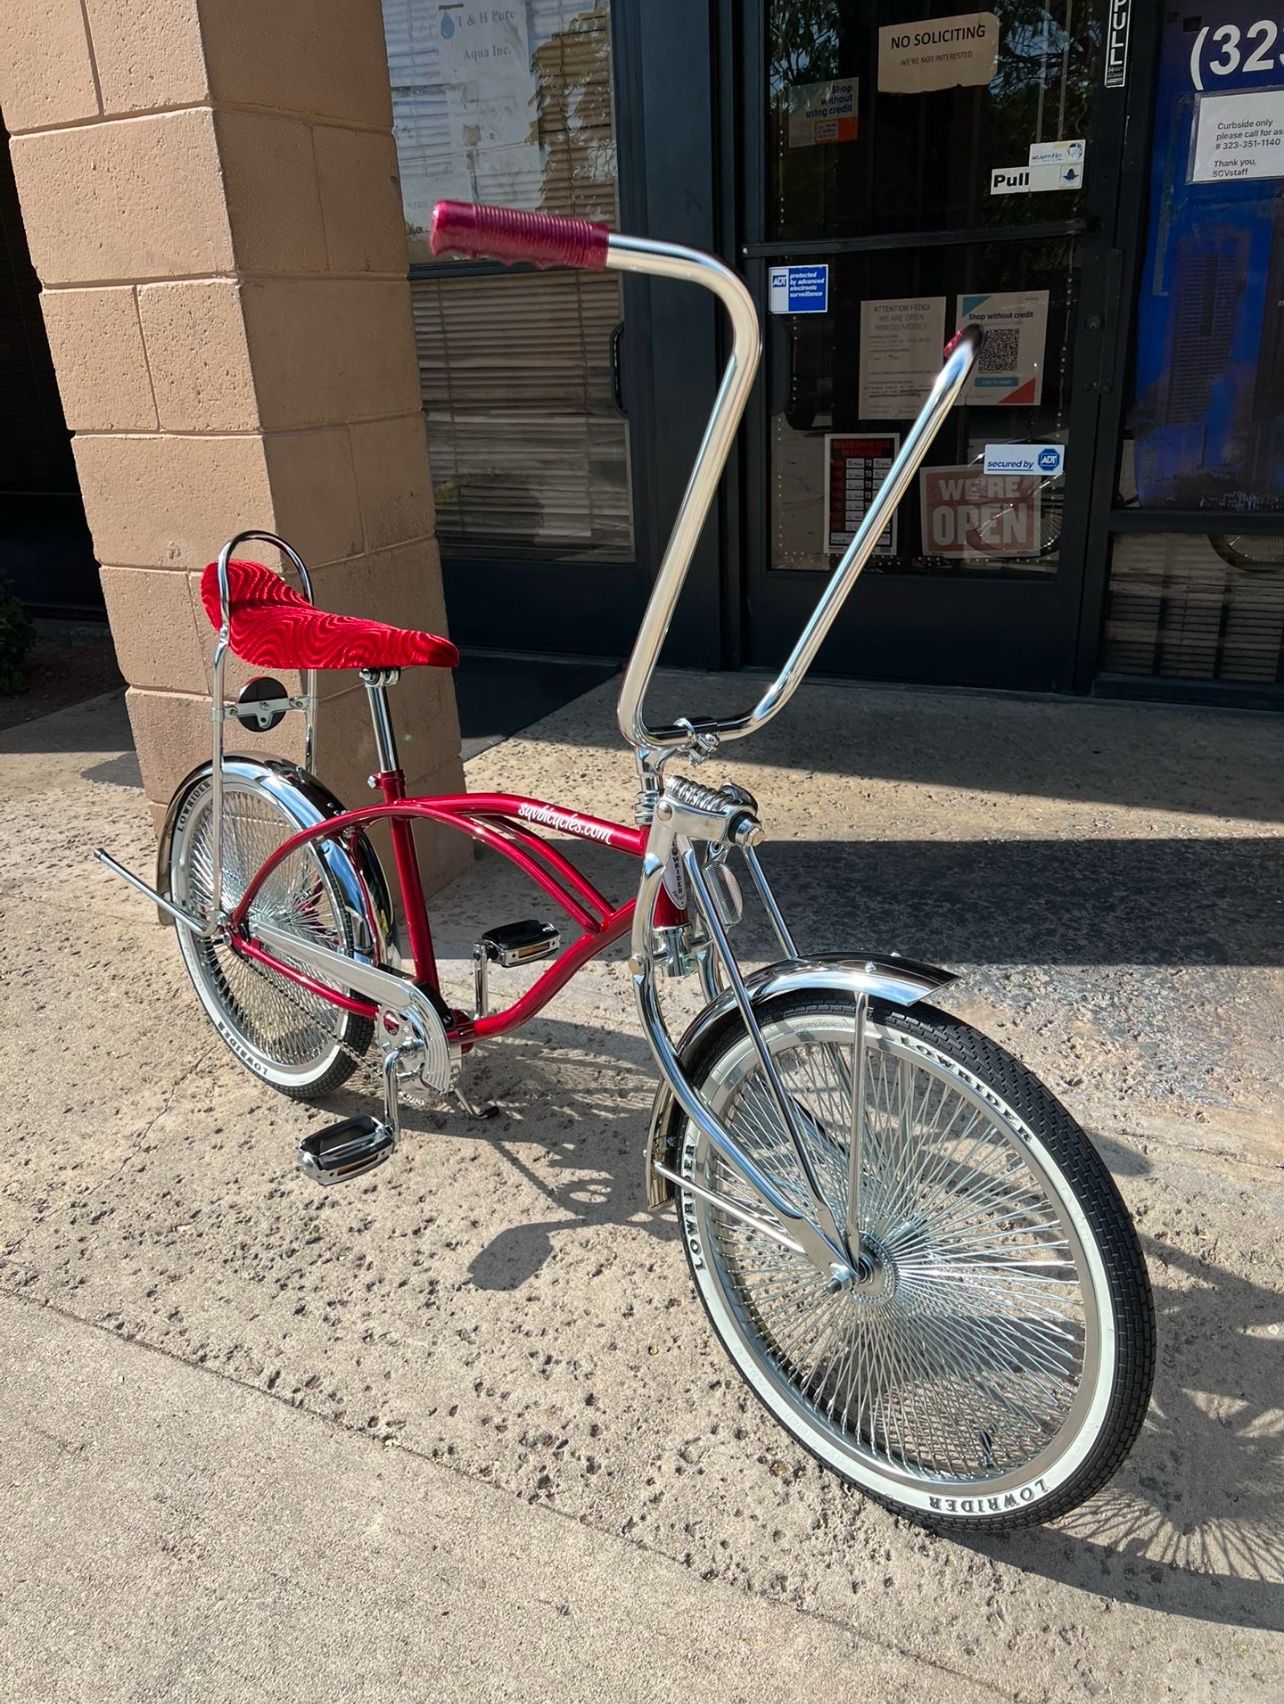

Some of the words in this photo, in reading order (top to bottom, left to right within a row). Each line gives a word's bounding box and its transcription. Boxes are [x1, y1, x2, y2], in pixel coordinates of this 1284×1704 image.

[467, 14, 476, 26] &
[479, 12, 488, 22] H
[890, 35, 911, 49] NO
[913, 24, 986, 46] SOLICITING
[1110, 0, 1127, 66] PULL
[463, 48, 489, 63] Aqua
[920, 56, 934, 64] NOT
[935, 50, 973, 62] INTERESTED
[1189, 19, 1284, 91] (32
[831, 84, 853, 94] Shop
[820, 94, 853, 105] without
[805, 109, 828, 118] using
[828, 104, 853, 115] credit
[1217, 120, 1254, 130] Curbside
[1255, 118, 1273, 127] only
[1216, 132, 1243, 141] please
[1244, 130, 1259, 138] call
[1260, 129, 1271, 137] for
[1222, 138, 1281, 150] 323-351-1140
[1214, 159, 1238, 168] Thank
[993, 172, 1030, 188] Pull
[772, 276, 787, 286] ADT
[789, 271, 818, 280] protected
[968, 313, 986, 322] Shop
[986, 311, 1013, 320] without
[1013, 310, 1034, 319] credit
[987, 460, 1022, 468] secured
[1023, 460, 1034, 470] by
[1040, 456, 1057, 464] ADT
[932, 502, 1028, 546] OPEN
[177, 780, 211, 833] LOWRIDER
[217, 1020, 270, 1077] LOWRIDER
[900, 1036, 1032, 1142] LOWRIDER
[928, 1478, 1050, 1513] LOWRIDER
